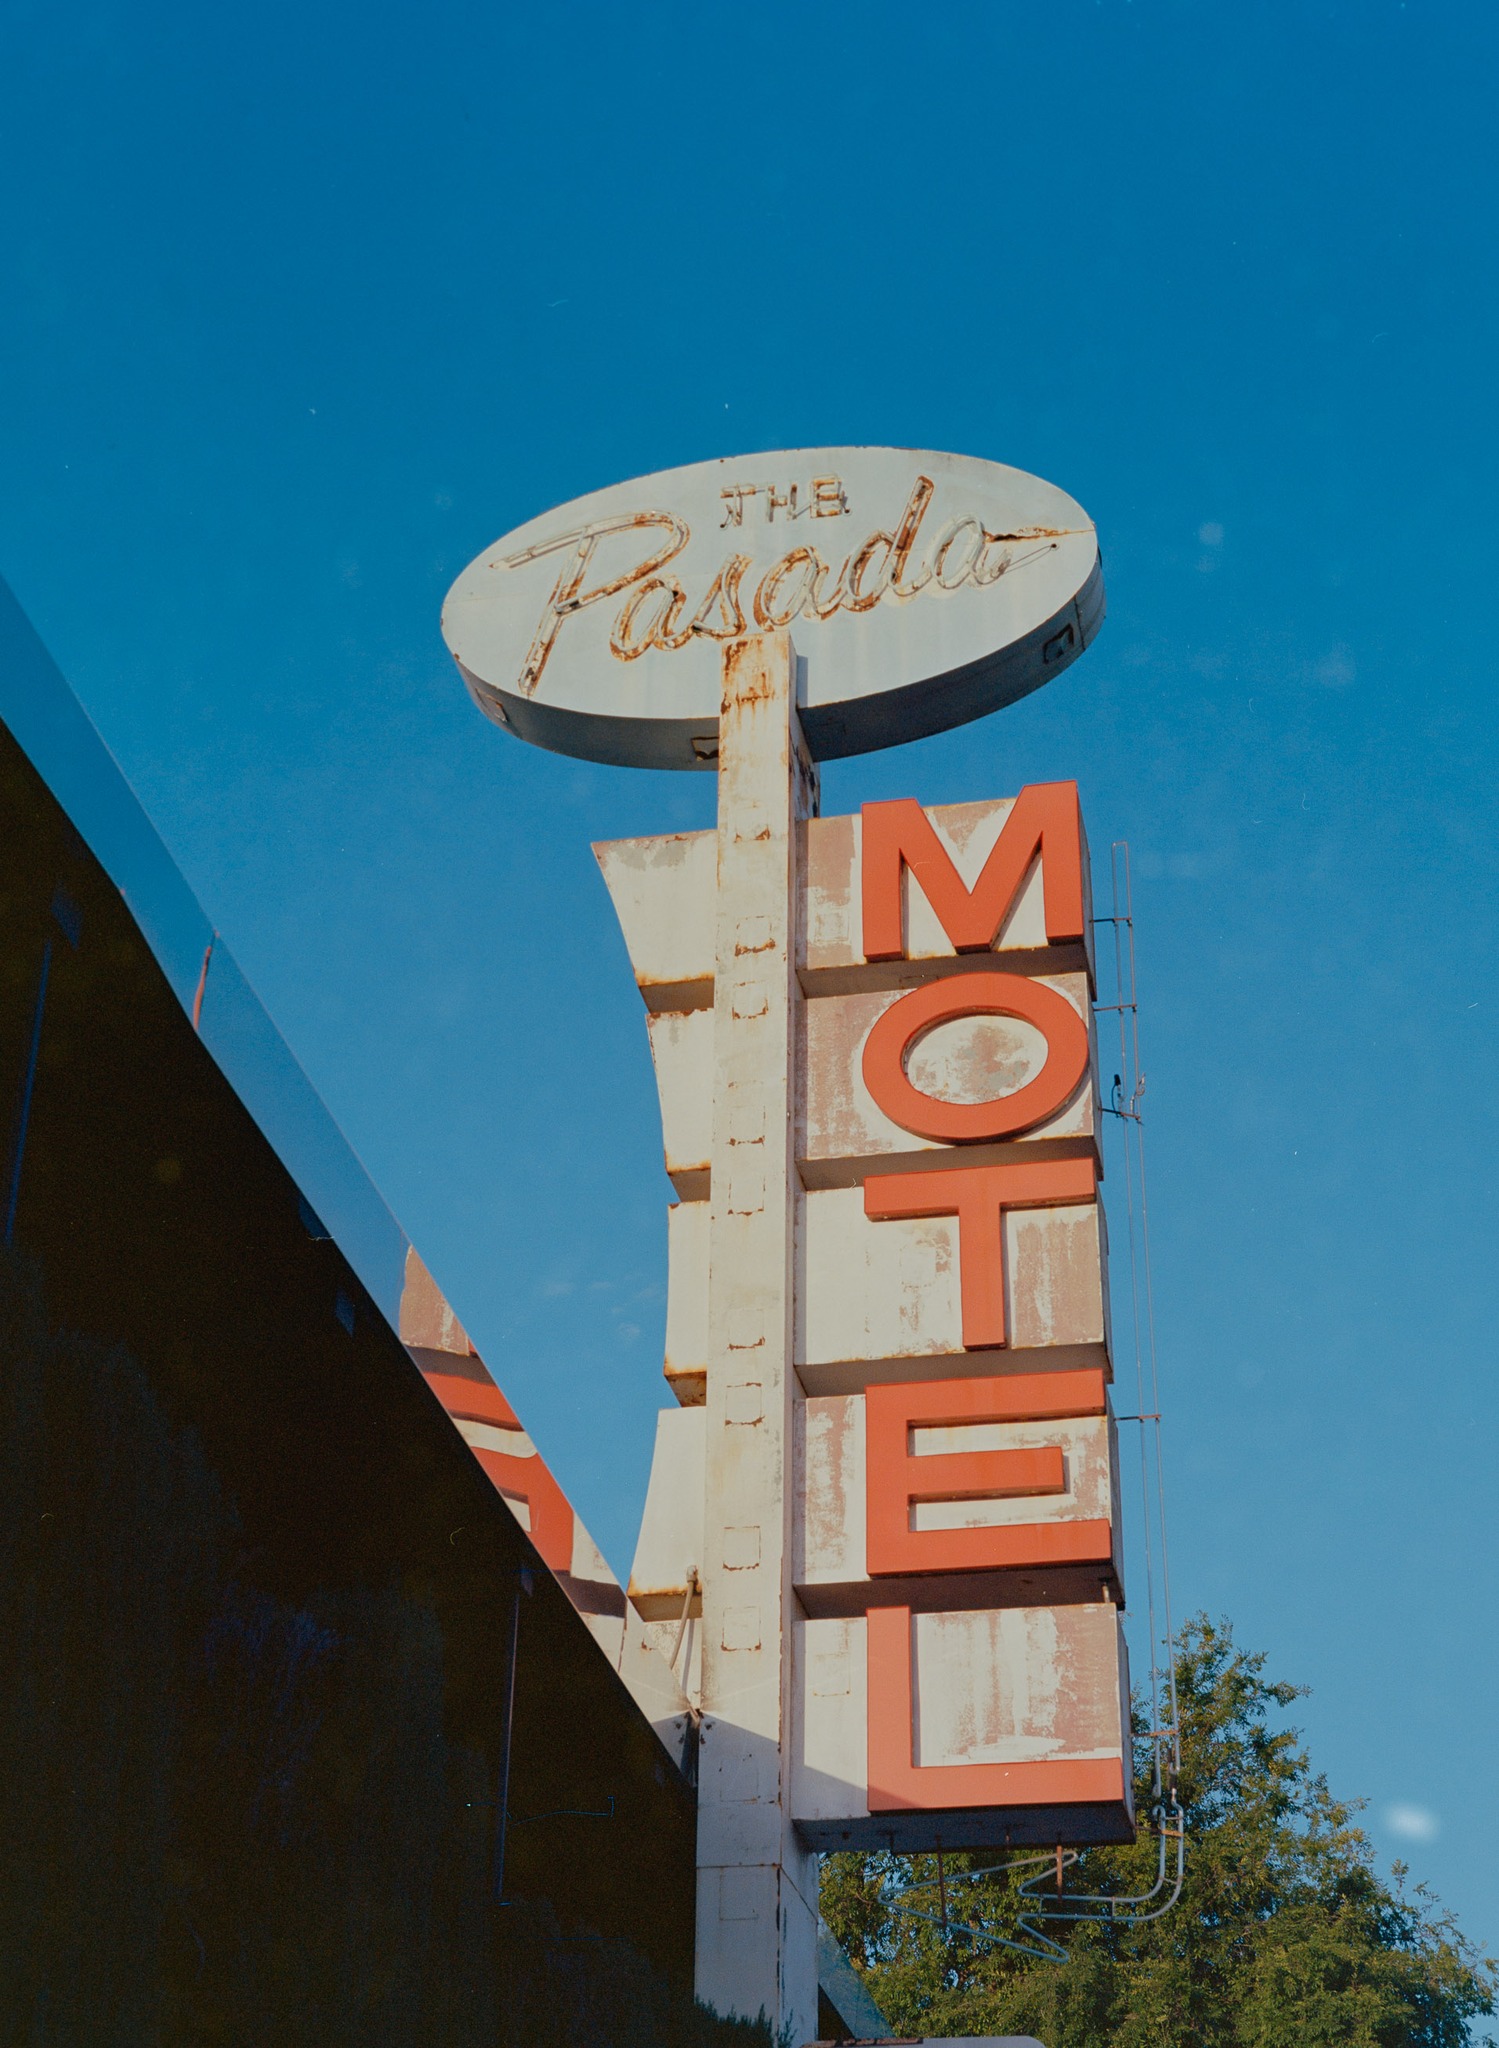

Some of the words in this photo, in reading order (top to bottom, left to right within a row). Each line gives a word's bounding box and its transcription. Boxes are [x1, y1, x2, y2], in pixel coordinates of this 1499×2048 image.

[489, 476, 1058, 696] Pasada
[720, 474, 850, 527] THE
[861, 780, 1124, 1812] MOTEL
